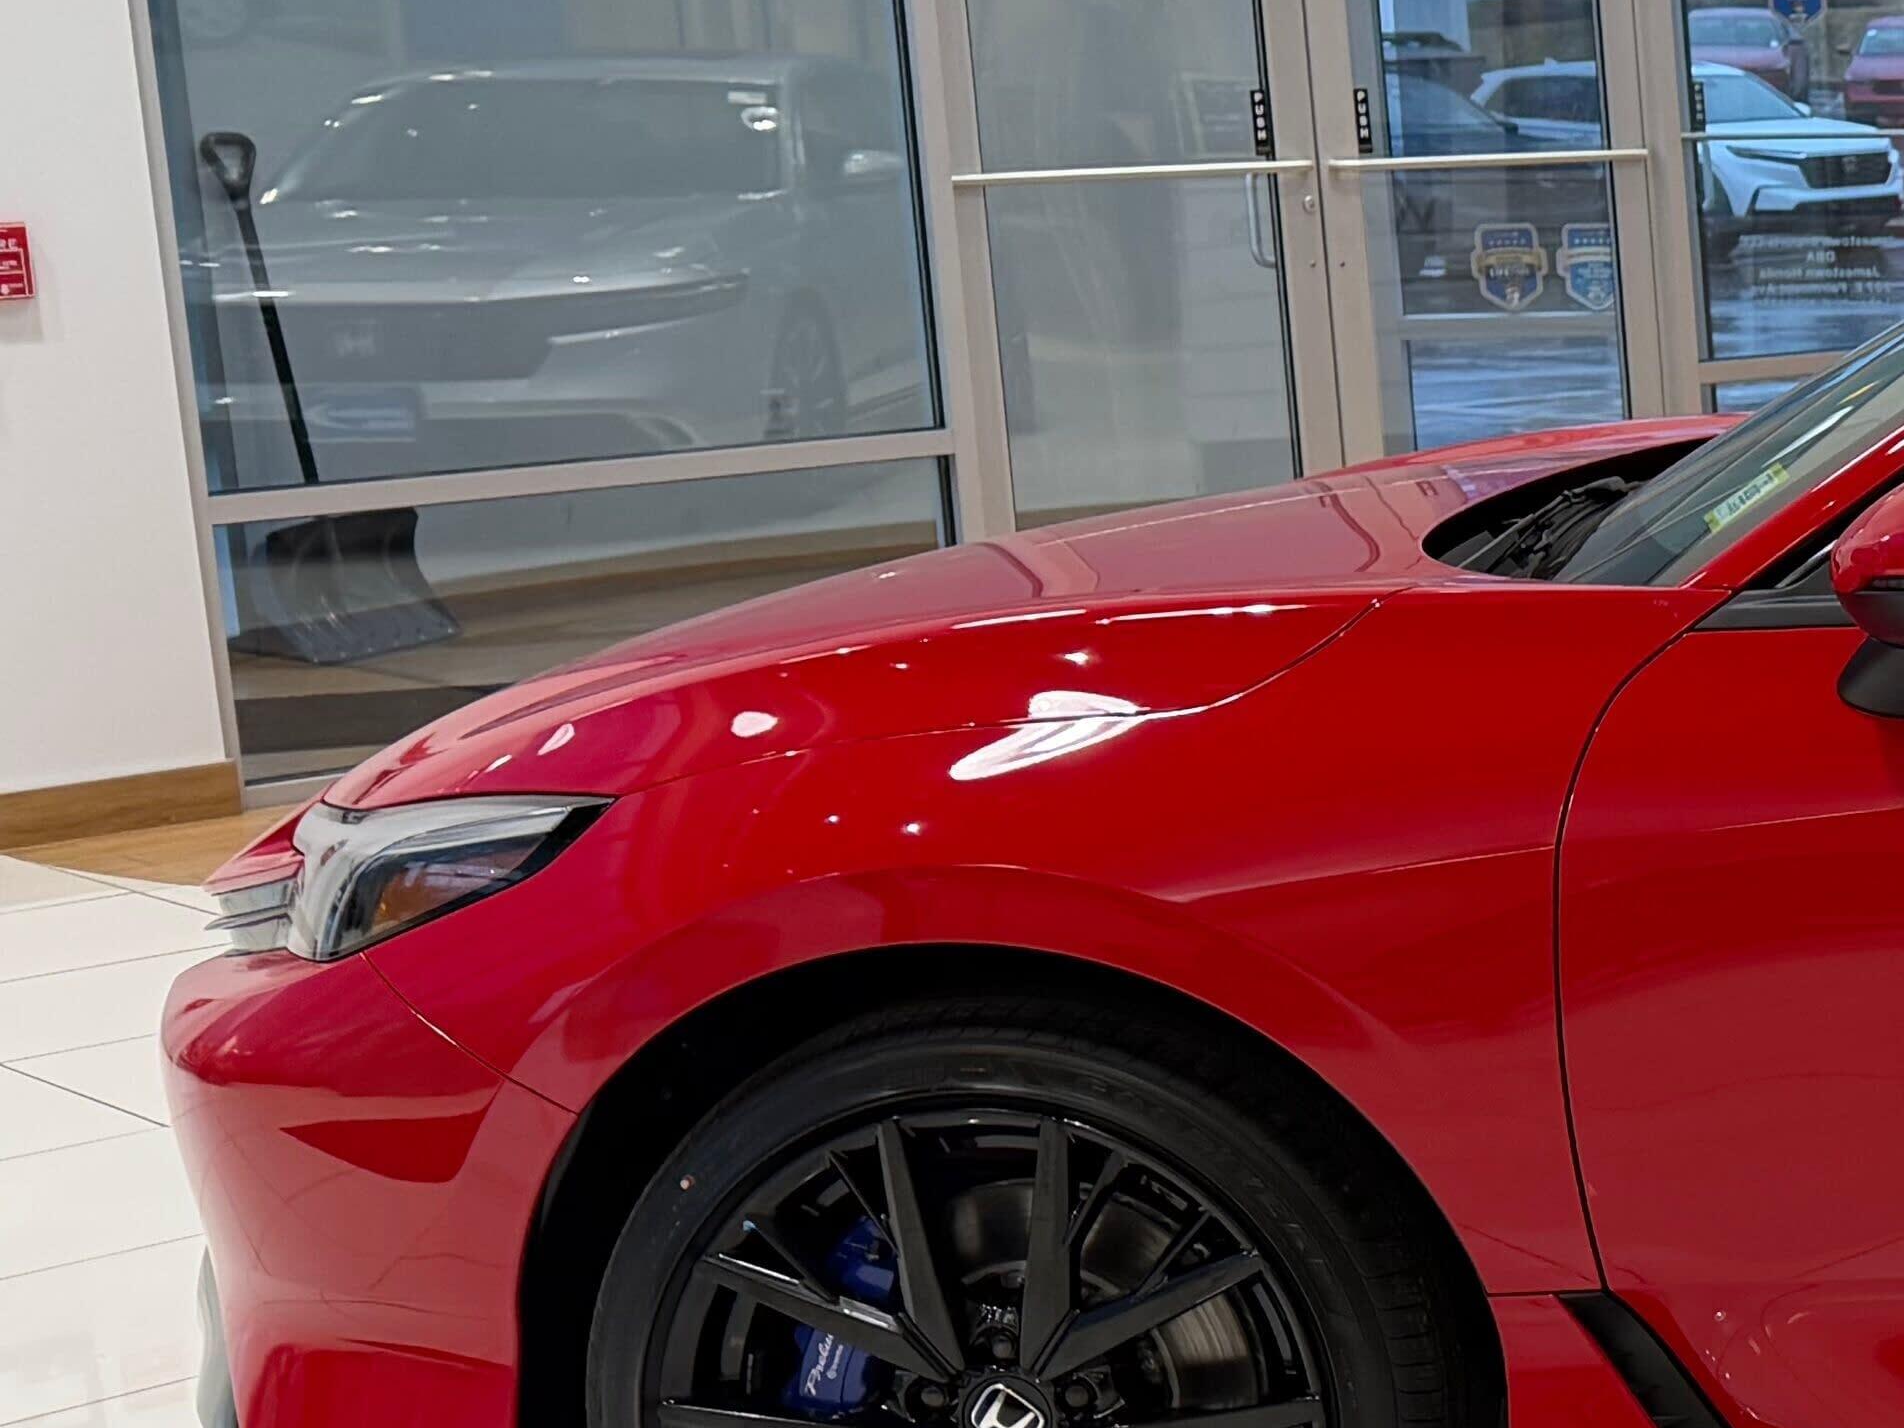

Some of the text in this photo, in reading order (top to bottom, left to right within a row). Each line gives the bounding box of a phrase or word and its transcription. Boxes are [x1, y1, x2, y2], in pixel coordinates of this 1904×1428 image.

[1254, 92, 1267, 140] PUSH
[1356, 90, 1369, 139] PUSH
[805, 1333, 834, 1396] Prelu
